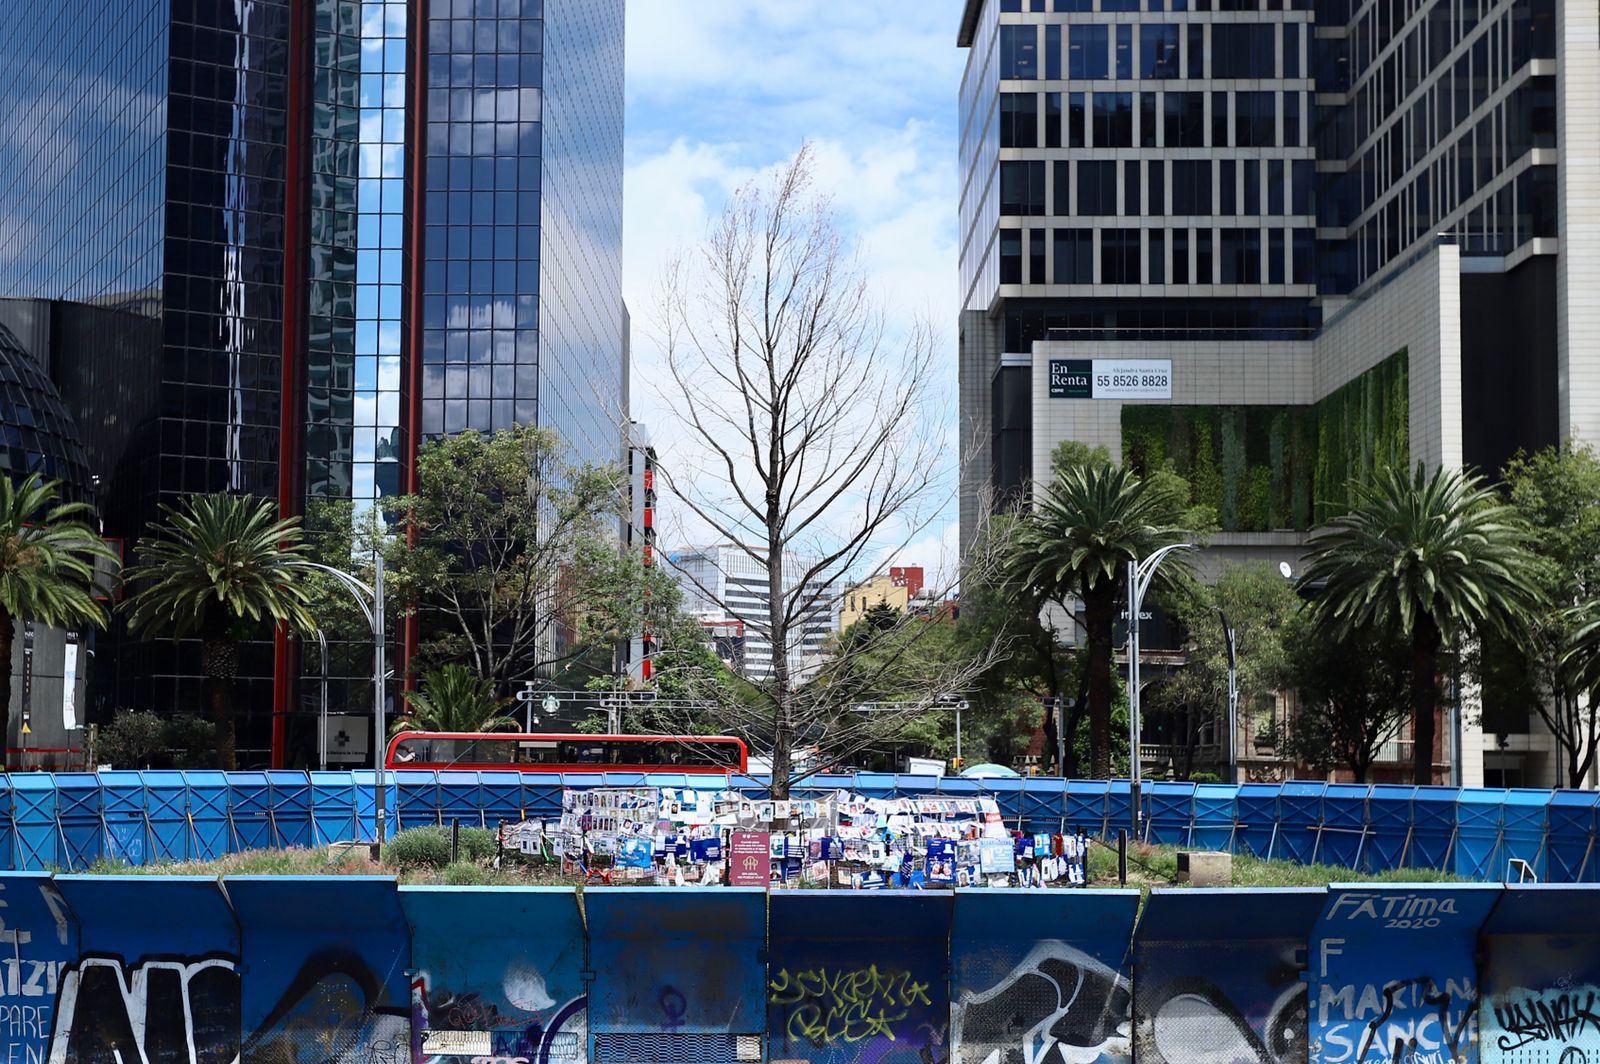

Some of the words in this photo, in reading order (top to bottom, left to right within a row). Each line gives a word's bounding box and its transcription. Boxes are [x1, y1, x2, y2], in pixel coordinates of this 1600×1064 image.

[1051, 362, 1068, 374] En
[1051, 374, 1088, 386] Renta
[1097, 375, 1110, 387] 55
[1113, 375, 1139, 387] 8526
[1141, 375, 1168, 387] 8828
[1384, 918, 1441, 929] 2020
